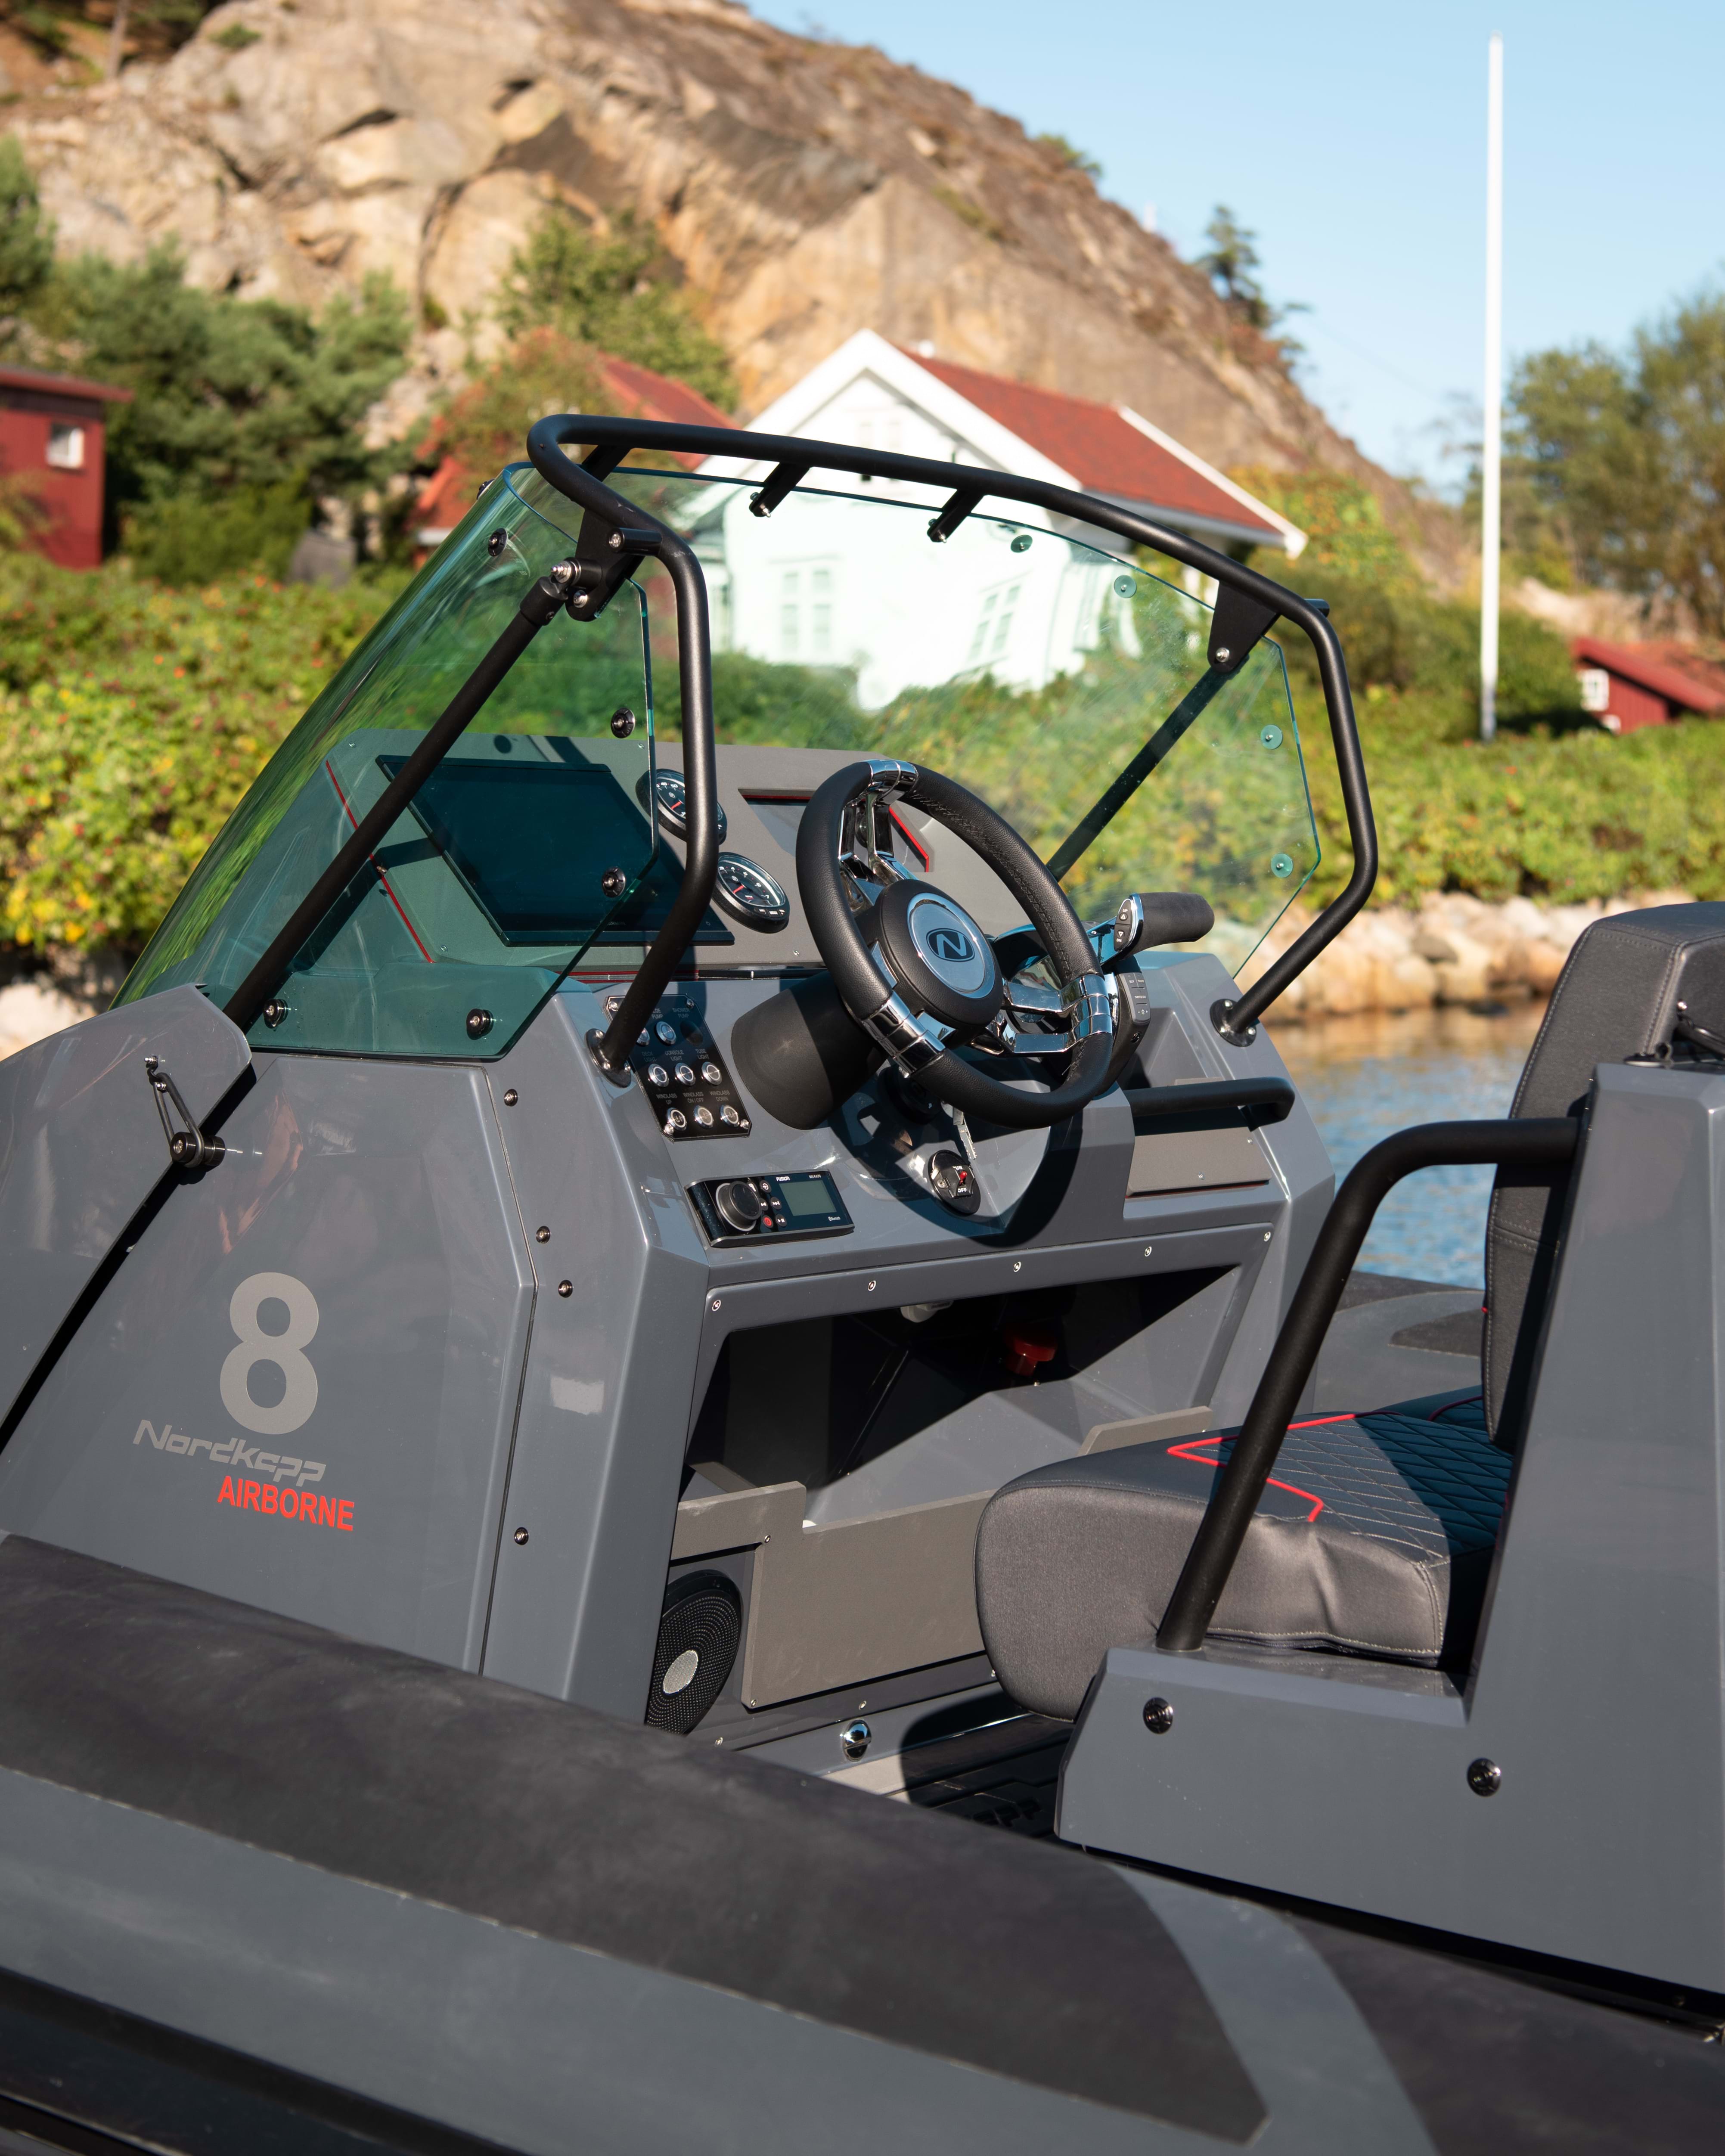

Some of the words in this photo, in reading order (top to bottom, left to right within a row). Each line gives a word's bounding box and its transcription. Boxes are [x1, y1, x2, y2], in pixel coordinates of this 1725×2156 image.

[220, 1272, 319, 1435] 8
[133, 1419, 326, 1487] Nordkapp
[217, 1475, 354, 1531] AIRBORNE
